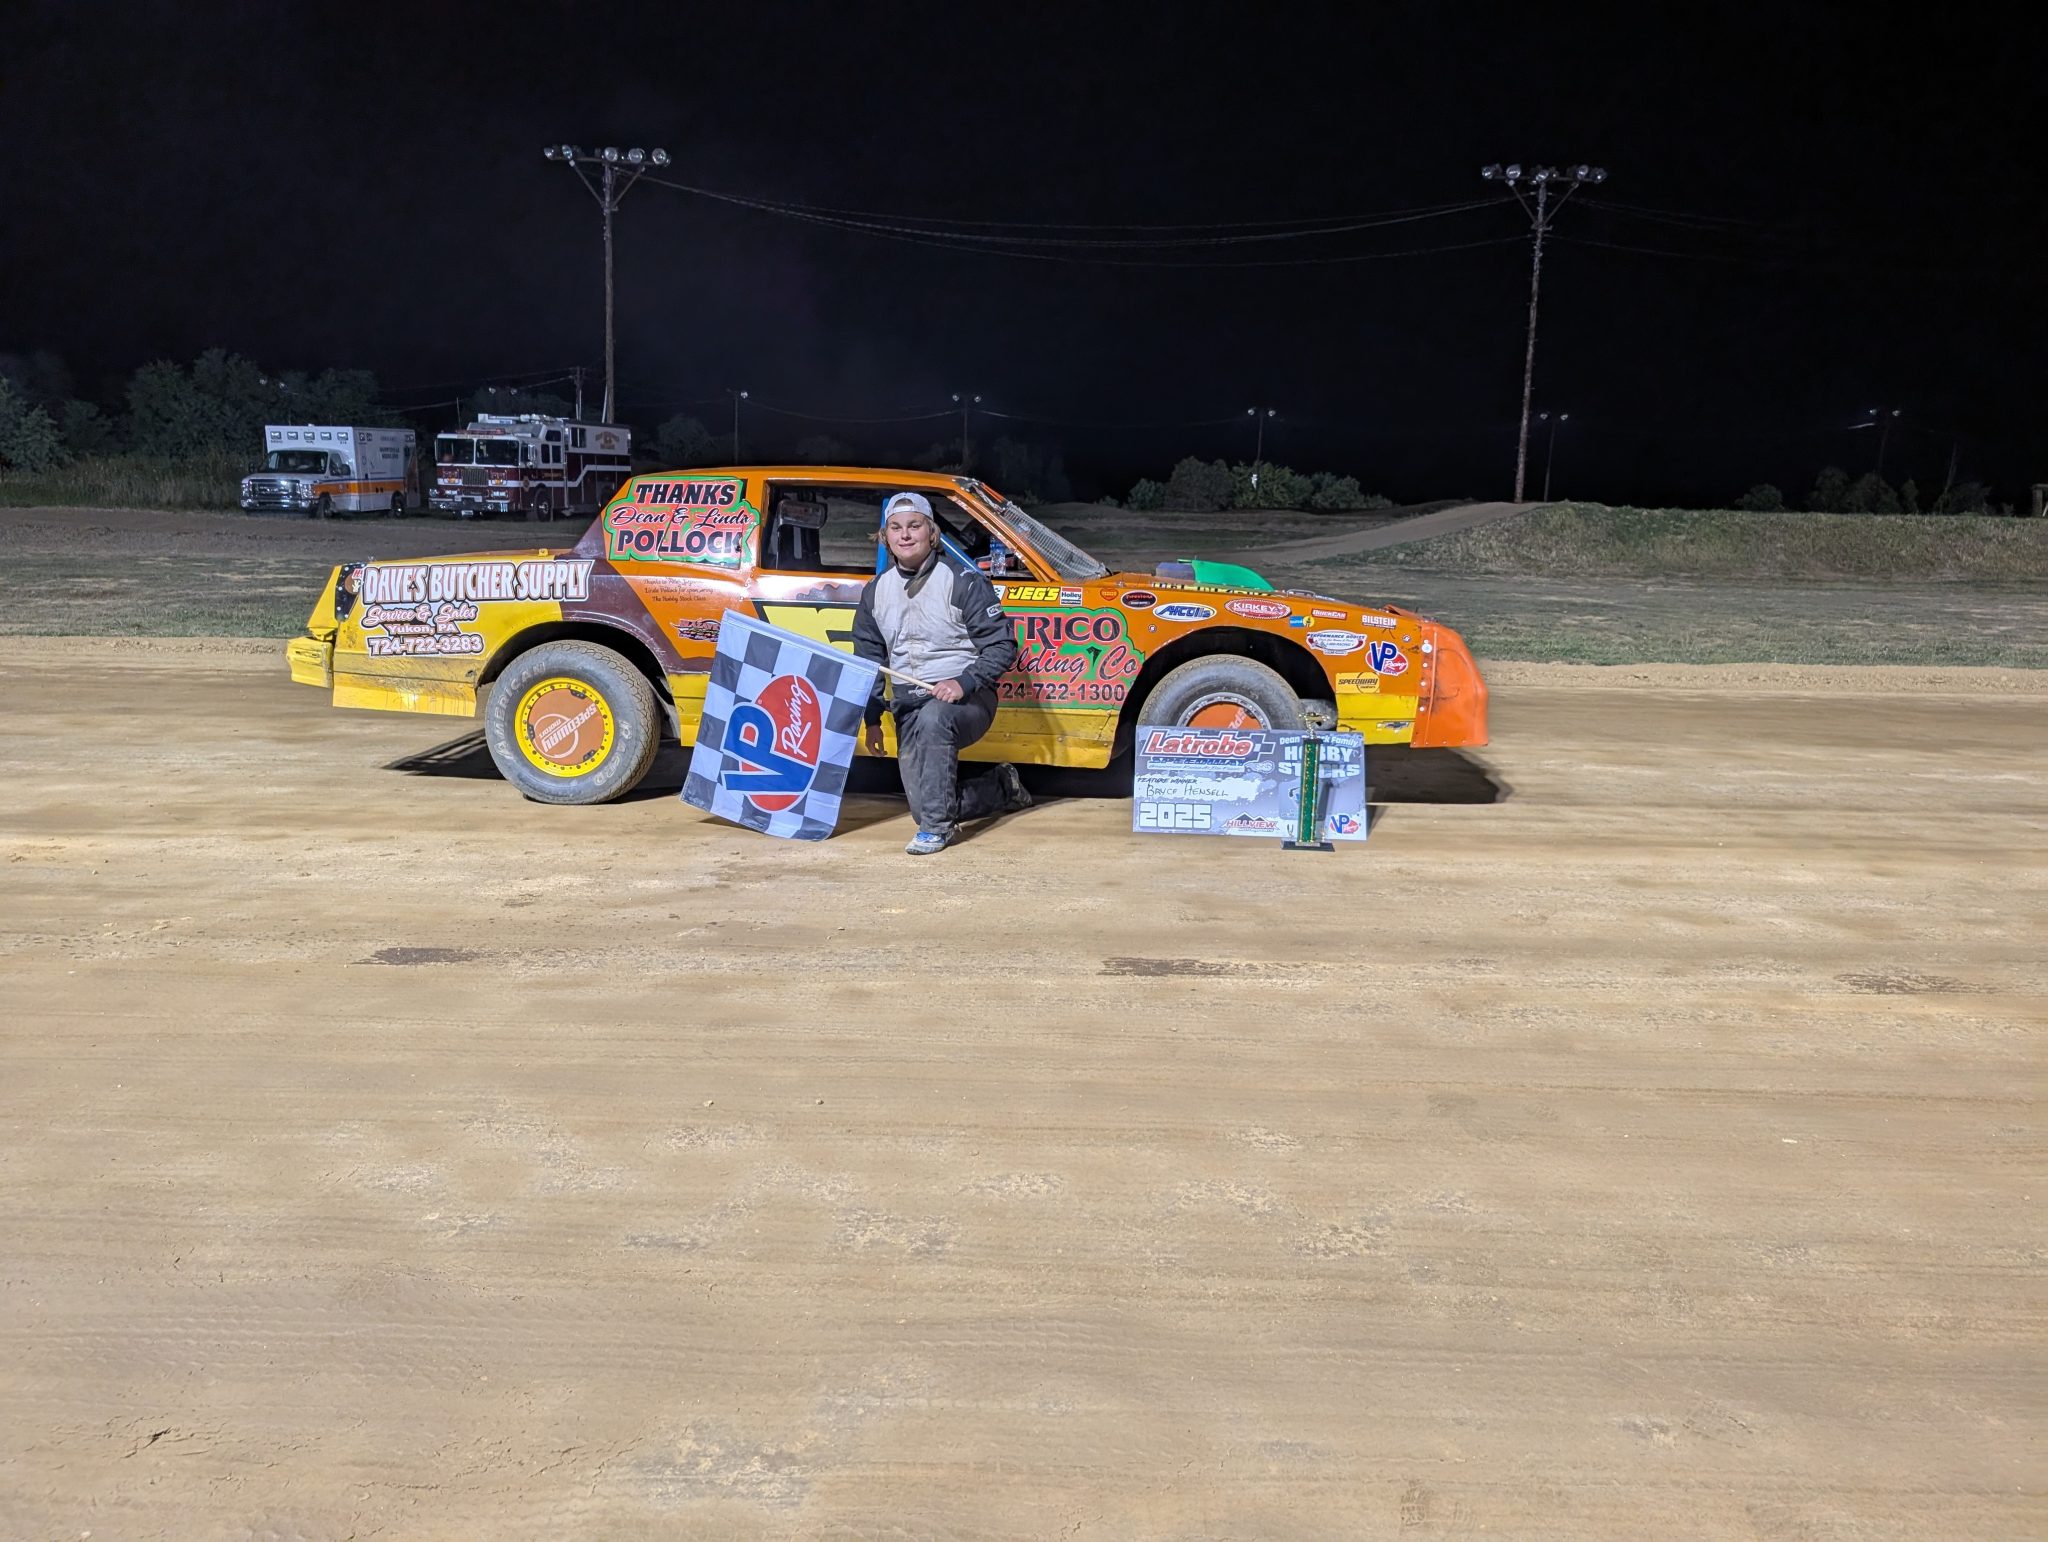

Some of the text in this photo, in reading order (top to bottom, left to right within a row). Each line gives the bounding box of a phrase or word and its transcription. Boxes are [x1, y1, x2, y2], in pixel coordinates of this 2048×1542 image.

[636, 483, 736, 506] THANKS
[611, 506, 751, 529] Dean & Linda
[617, 529, 744, 554] POLLOCK
[365, 561, 592, 602] DAVE'S BUTCHER SUPPLY
[1008, 586, 1061, 601] JEG'S
[1061, 592, 1082, 600] Holley
[365, 602, 477, 624] Service & Sales
[1233, 602, 1277, 612] KIRKEY
[387, 623, 459, 635] Yukon, PA
[1361, 614, 1397, 627] BILSTEIN
[369, 635, 483, 655] 724-722-3283
[1099, 645, 1137, 681] Co
[1370, 641, 1398, 672] VP
[1338, 678, 1379, 686] SPEEDWAY
[493, 661, 546, 760] AMERICAN
[780, 675, 812, 758] Racing
[540, 702, 599, 753] SPEEDWAY
[722, 703, 815, 791] VP
[1146, 731, 1253, 757] Latrobe
[1279, 736, 1300, 745] Dean
[1331, 736, 1359, 747] Family
[1284, 745, 1353, 763] HBY
[1278, 761, 1360, 778] STCKS
[1139, 801, 1212, 829] 2025
[1226, 820, 1277, 830] HILLVIEW
[1330, 814, 1350, 834] VP
